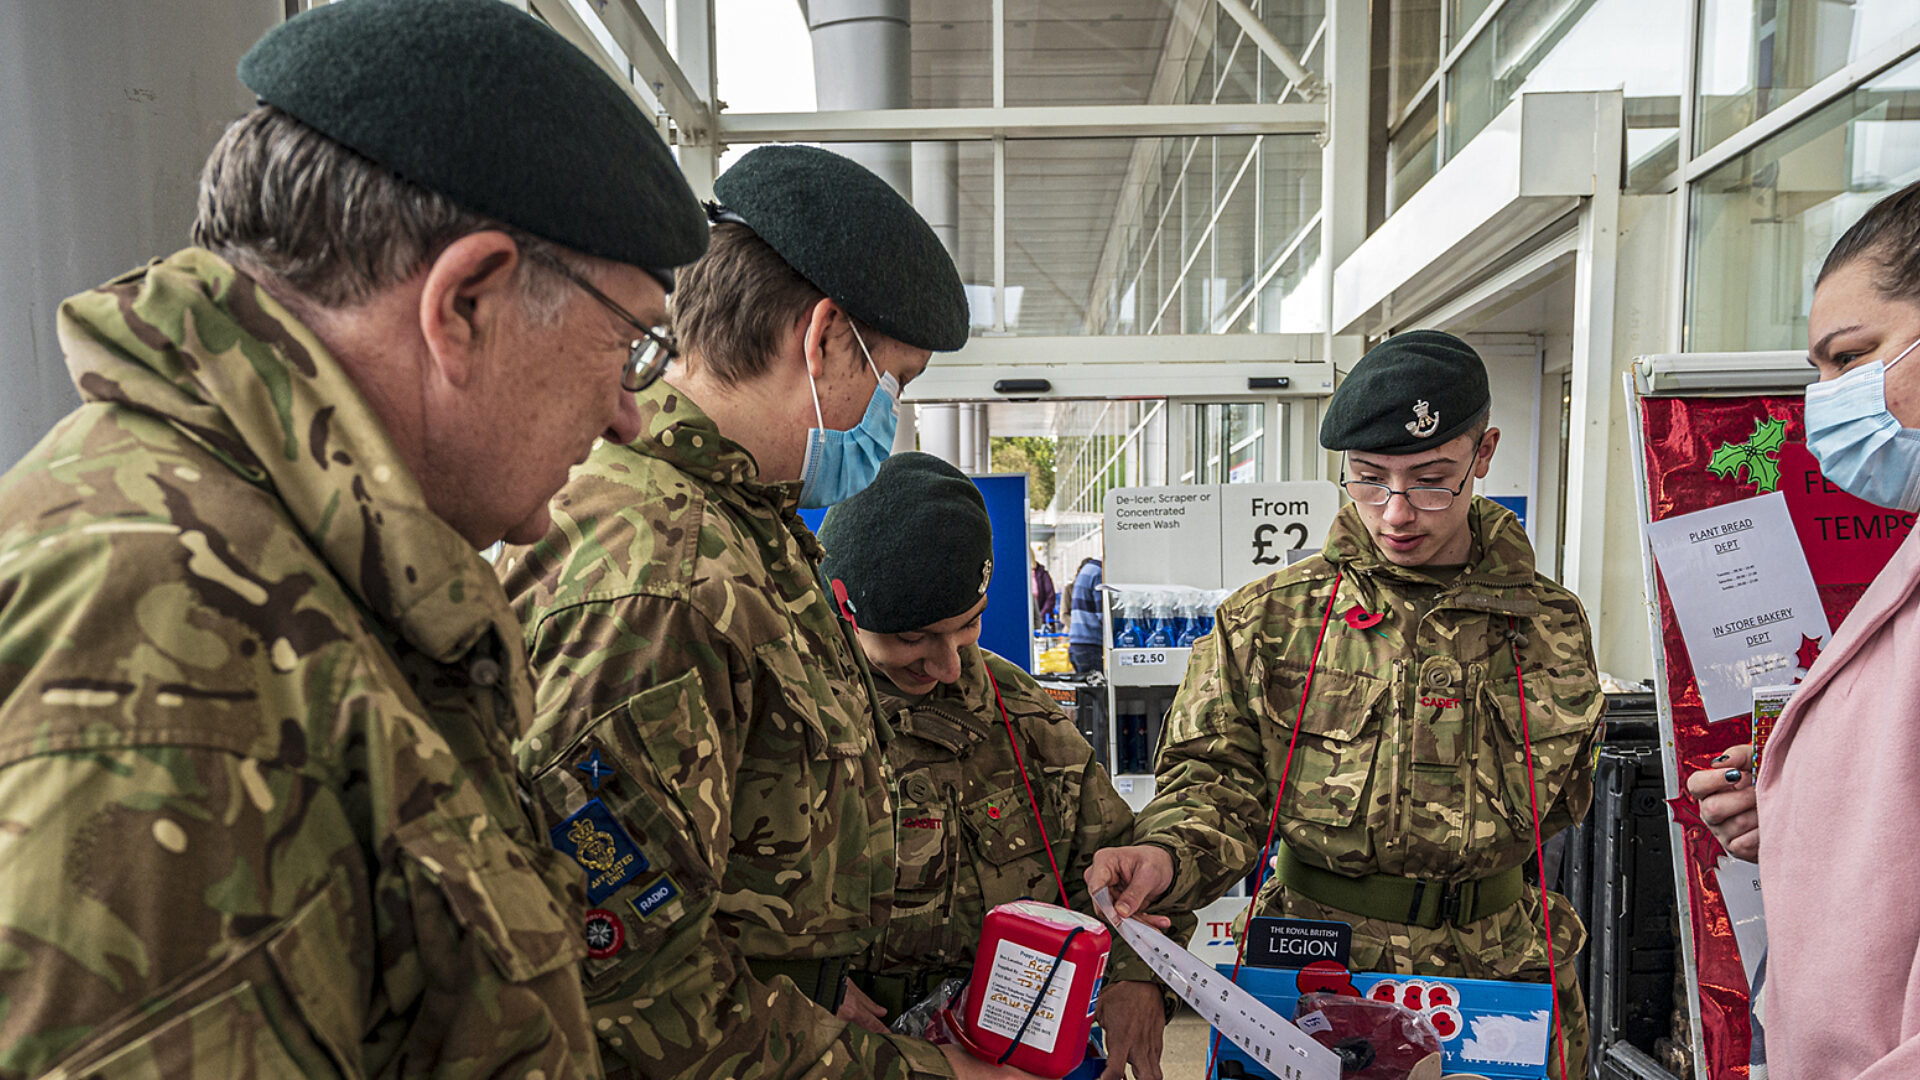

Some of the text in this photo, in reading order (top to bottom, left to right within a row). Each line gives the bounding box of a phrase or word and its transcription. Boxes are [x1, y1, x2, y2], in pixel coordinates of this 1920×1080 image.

[1805, 471, 1847, 494] FE
[1116, 495, 1156, 505] De-Icer,
[1158, 494, 1197, 505] Scraper
[1116, 507, 1186, 517] Concentrated
[1252, 498, 1309, 516] From
[1116, 520, 1180, 530] Screen Wash
[1689, 519, 1753, 543] PLANT BREAD
[1715, 540, 1740, 554] DEPT
[1712, 608, 1794, 637] IN STORE BAKERY
[1746, 632, 1771, 646] DEPT
[1133, 654, 1165, 664] £2.50
[1421, 696, 1460, 708] CADET
[905, 817, 942, 829] CADET
[591, 853, 634, 889] AFFILIATED
[607, 869, 627, 887] UNIT
[639, 887, 670, 911] RADIO
[1270, 926, 1339, 937] THE ROYAL BRITISH
[1269, 937, 1337, 957] LEGION
